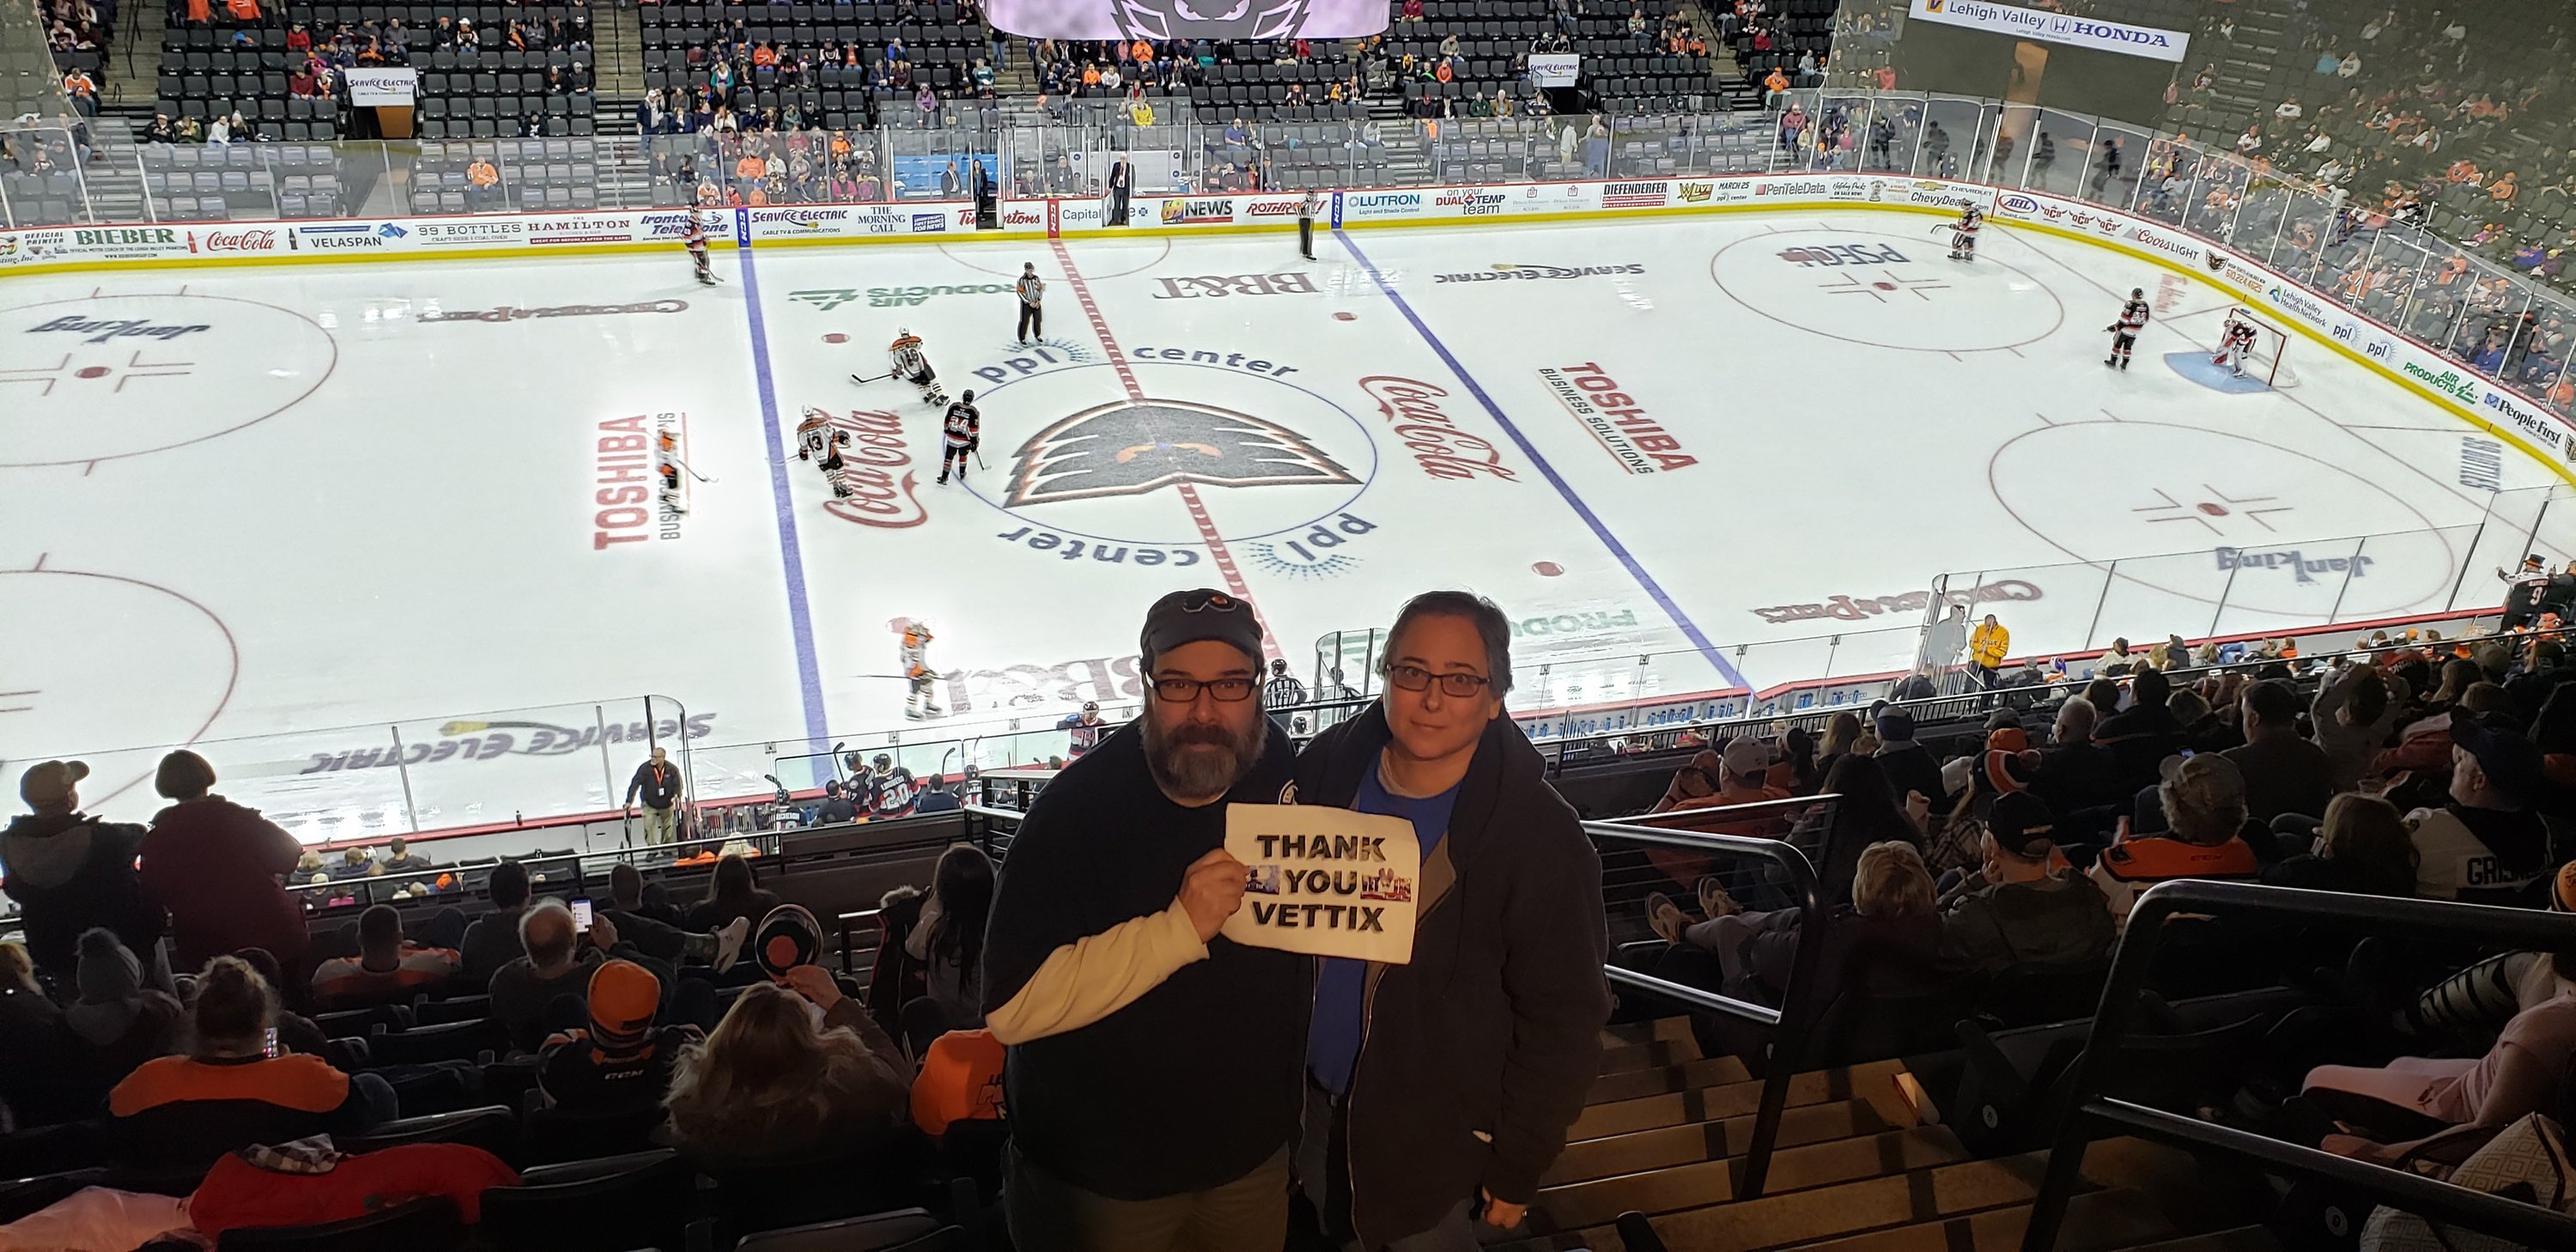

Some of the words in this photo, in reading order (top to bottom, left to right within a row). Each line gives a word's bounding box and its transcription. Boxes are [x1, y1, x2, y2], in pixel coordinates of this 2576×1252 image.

[1949, 1, 1997, 21] Lehigh
[2000, 9, 2046, 30] Valley
[2073, 21, 2170, 48] HONDA
[349, 78, 380, 88] SERVICE
[383, 78, 415, 87] ELECTRIC
[1462, 187, 1484, 198] your
[1604, 182, 1668, 196] DIEFENDERFER
[1718, 182, 1740, 191] MARCH
[1741, 181, 1750, 190] 25
[1765, 181, 1826, 196] PenTeleData
[1951, 185, 1992, 197] CHEVROLET
[1161, 198, 1184, 220] 69
[1185, 200, 1233, 216] NEWS
[1359, 194, 1419, 207] LUTRON
[1436, 196, 1464, 207] DUAL
[1475, 194, 1505, 204] TEMP
[2004, 198, 2031, 210] AHL
[751, 210, 800, 223] SERVICE
[800, 209, 848, 222] ELECTRIC
[871, 206, 892, 215] THE
[1062, 208, 1102, 221] Capital
[1463, 204, 1499, 216] team
[528, 219, 630, 232] HAMILTON
[858, 214, 907, 225] MORNING
[871, 223, 896, 233] CALL
[74, 228, 177, 246] BIEBER
[418, 227, 439, 236] 99
[447, 223, 521, 235] BOTTLES
[206, 229, 276, 251] Coca-Cola
[311, 236, 382, 248] VELASPAN
[2137, 228, 2171, 252] Coors
[2170, 240, 2199, 261] LIGHT
[1435, 268, 1540, 283] ELECTRIC
[1540, 263, 1645, 280] SERVICE
[1152, 272, 1322, 301] BB&T
[869, 296, 929, 307] AIR
[2283, 289, 2304, 308] Lehigh
[2304, 299, 2322, 315] Valley
[2280, 297, 2300, 313] Health
[2300, 308, 2327, 327] Network
[2333, 323, 2351, 341] ppl
[2366, 341, 2388, 358] ppl
[972, 348, 1058, 384] ppl
[1133, 345, 1298, 378] center
[2403, 362, 2456, 394] PRODUCTS
[2440, 370, 2460, 386] AIR
[1538, 368, 1595, 416] BUSINESS
[1586, 412, 1656, 475] SOLUTIONS
[1560, 362, 1699, 472] TOSHIBA
[2499, 398, 2537, 430] People
[2537, 420, 2561, 445] First
[1358, 375, 1522, 483] Coca-Cola
[593, 414, 649, 550] TOSHIBA
[998, 526, 1200, 568] center
[1285, 513, 1378, 562] ppl
[528, 712, 717, 753] SERVICE
[299, 732, 521, 775] ELECTRIC
[884, 781, 910, 811] 20
[1256, 834, 1387, 862] THANK
[1285, 869, 1358, 896] YOU
[1252, 901, 1384, 933] VETTIX
